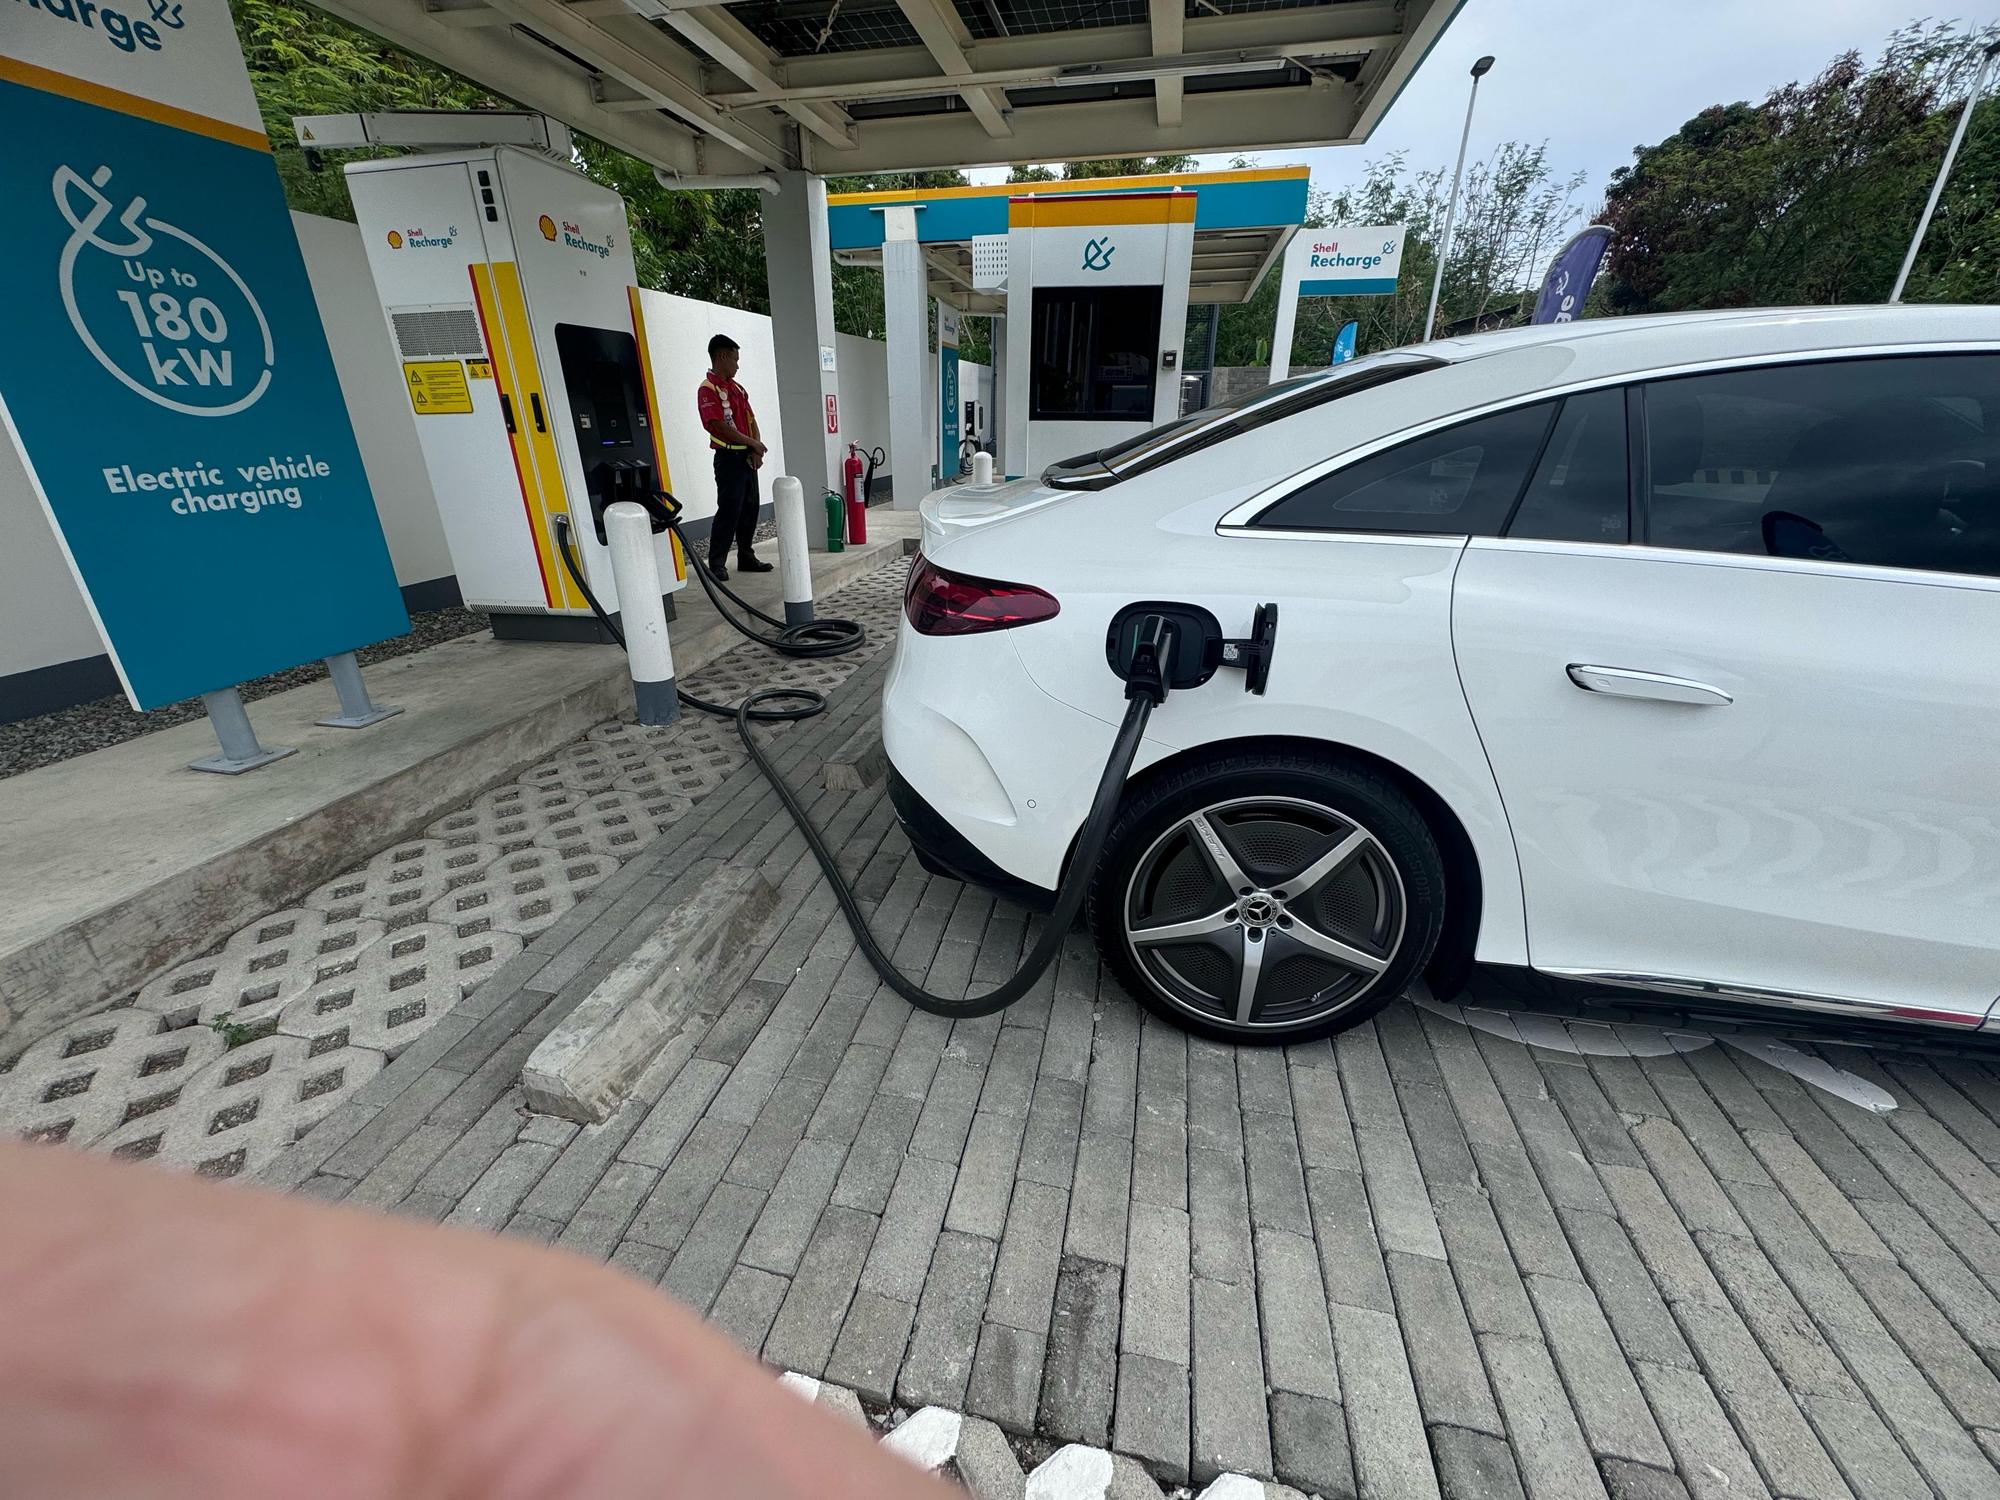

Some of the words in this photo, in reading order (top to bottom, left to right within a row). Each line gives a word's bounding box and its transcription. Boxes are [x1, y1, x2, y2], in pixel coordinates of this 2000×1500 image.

[12, 0, 162, 52] arge
[406, 228, 423, 237] Shell
[562, 221, 580, 234] Shell
[409, 236, 453, 248] Recharge
[565, 232, 610, 258] Recharge
[1312, 242, 1338, 253] Shell
[123, 260, 165, 289] Up
[170, 268, 197, 288] to
[1310, 254, 1382, 270] Recharge
[117, 289, 228, 343] 180
[142, 342, 233, 386] kW
[102, 461, 224, 494] Electric
[237, 454, 331, 483] vehicle
[171, 482, 302, 514] charging
